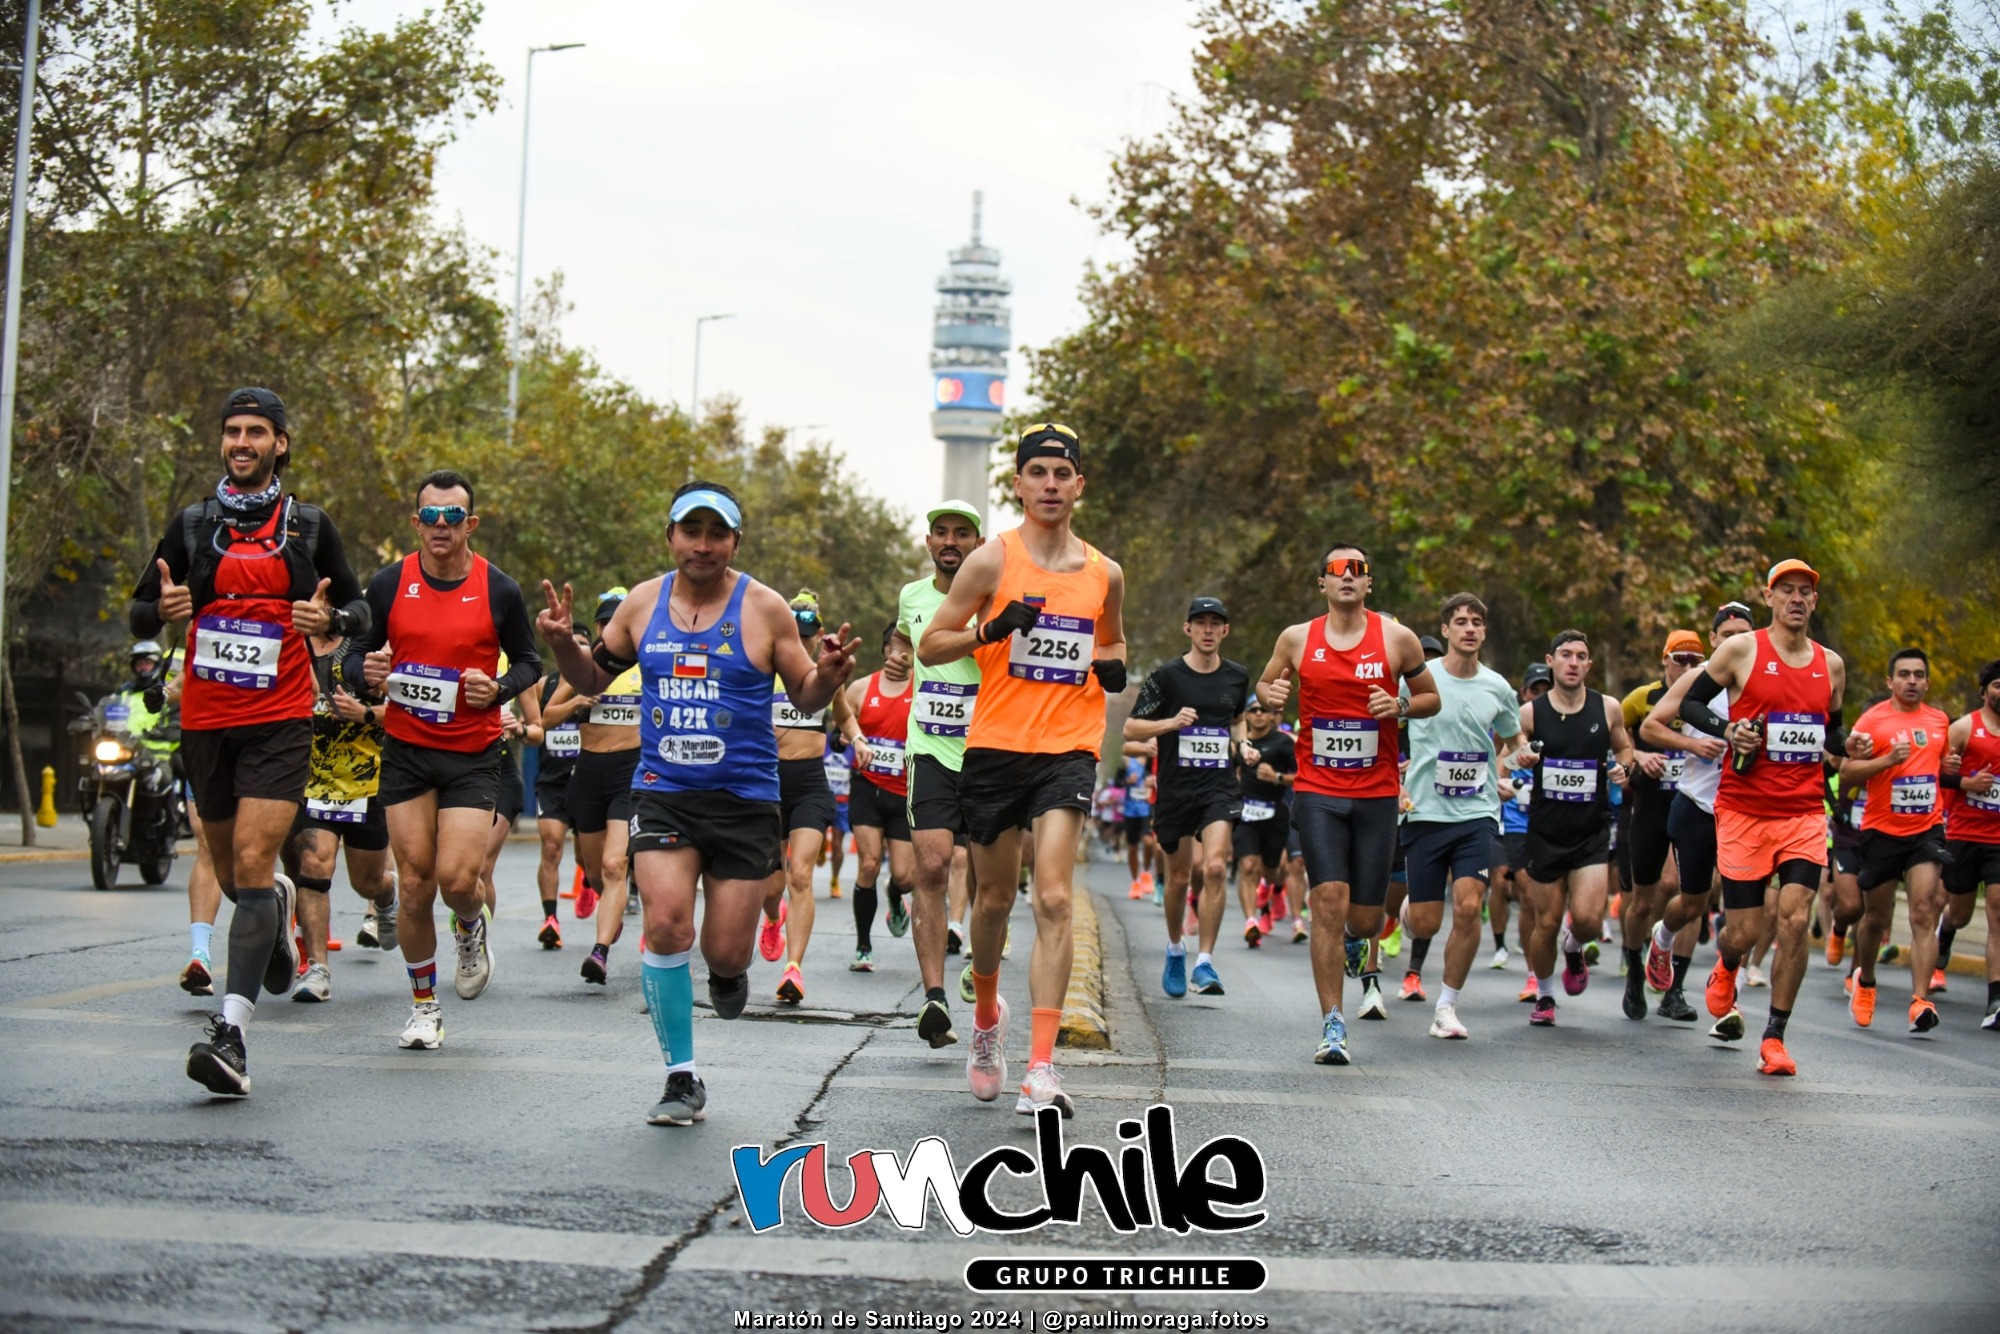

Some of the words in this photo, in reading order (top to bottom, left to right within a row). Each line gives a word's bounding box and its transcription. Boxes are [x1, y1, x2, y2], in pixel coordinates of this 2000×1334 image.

[212, 641, 261, 665] 1432
[1028, 637, 1079, 661] 2256
[1355, 662, 1384, 679] 42K
[400, 682, 441, 704] 3352
[658, 677, 720, 700] OSCAR
[602, 708, 634, 721] 5014
[929, 701, 965, 719] 1225
[669, 706, 709, 729] 42K
[553, 736, 579, 745] 4468
[681, 739, 718, 751] Maratón
[1326, 737, 1362, 752] 2191
[1779, 731, 1816, 745] 4244
[1191, 742, 1220, 754] 1253
[691, 751, 719, 760] Santiago
[872, 749, 896, 763] 265
[1449, 768, 1477, 781] 1662
[1554, 774, 1585, 787] 1659
[1901, 788, 1930, 801] 3446
